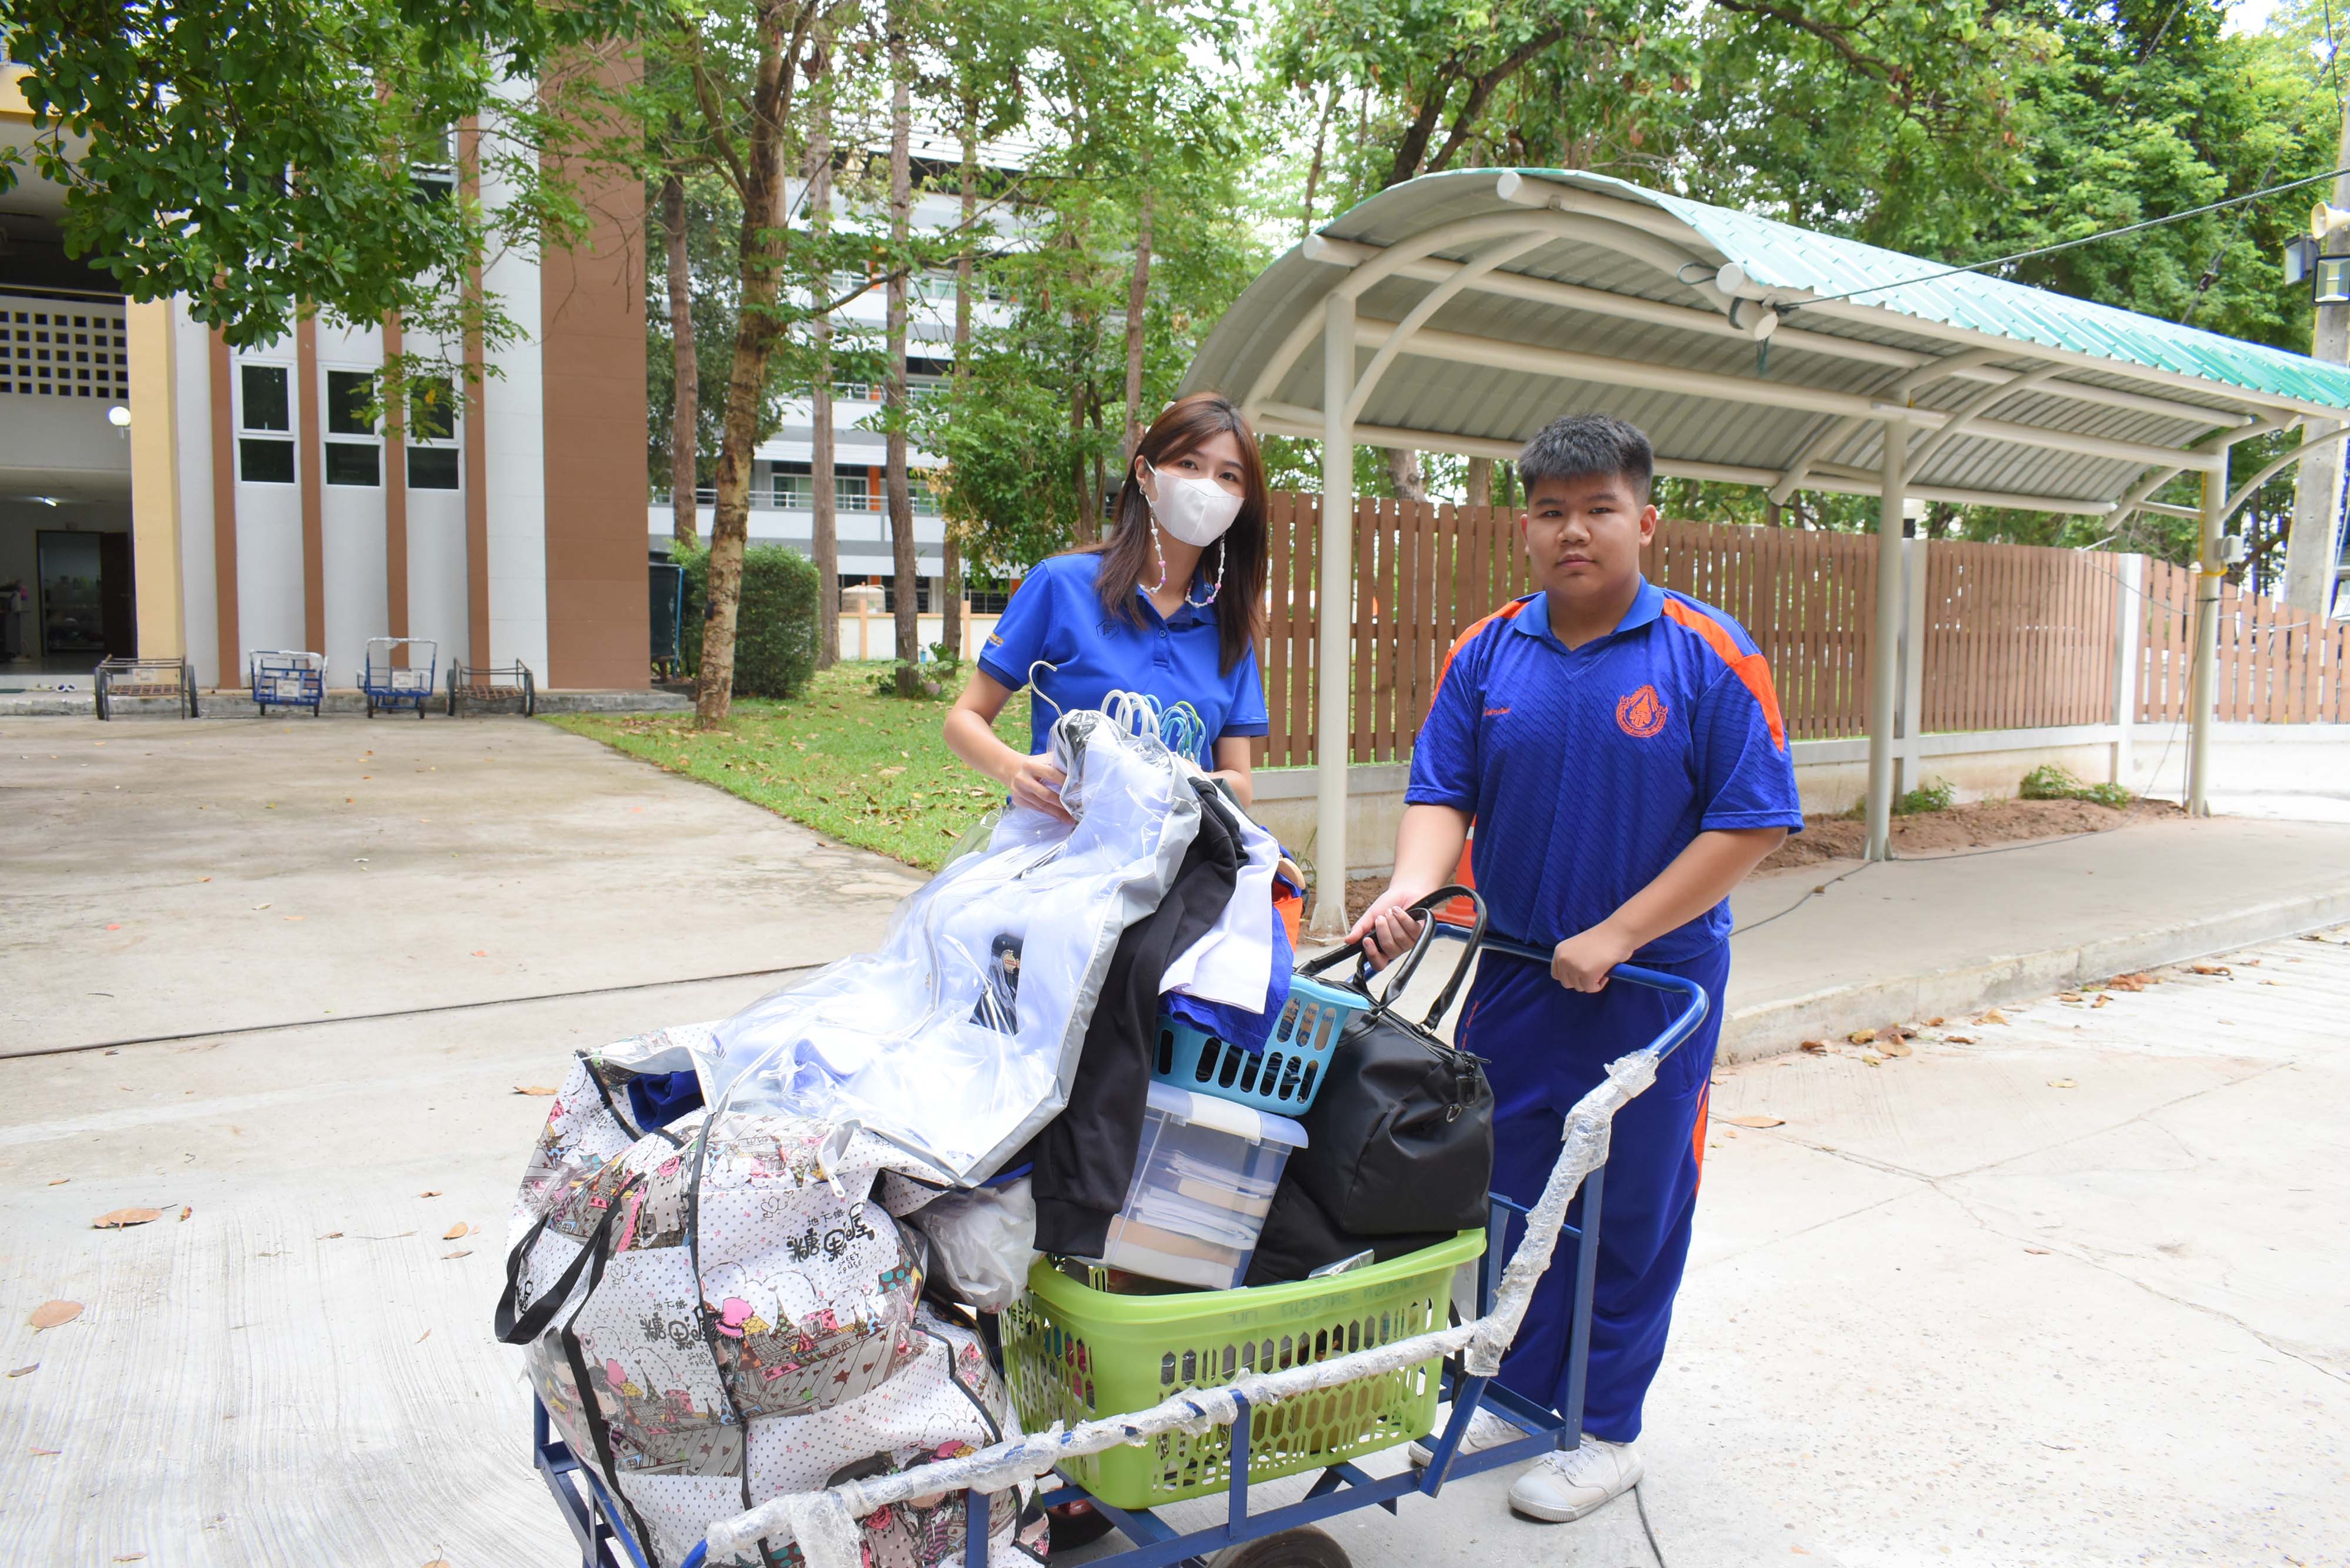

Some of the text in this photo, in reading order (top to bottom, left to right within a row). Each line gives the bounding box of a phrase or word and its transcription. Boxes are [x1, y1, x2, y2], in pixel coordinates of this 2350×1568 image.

[785, 1202, 875, 1262] 糖果屋
[838, 1260, 862, 1275] HOUSE
